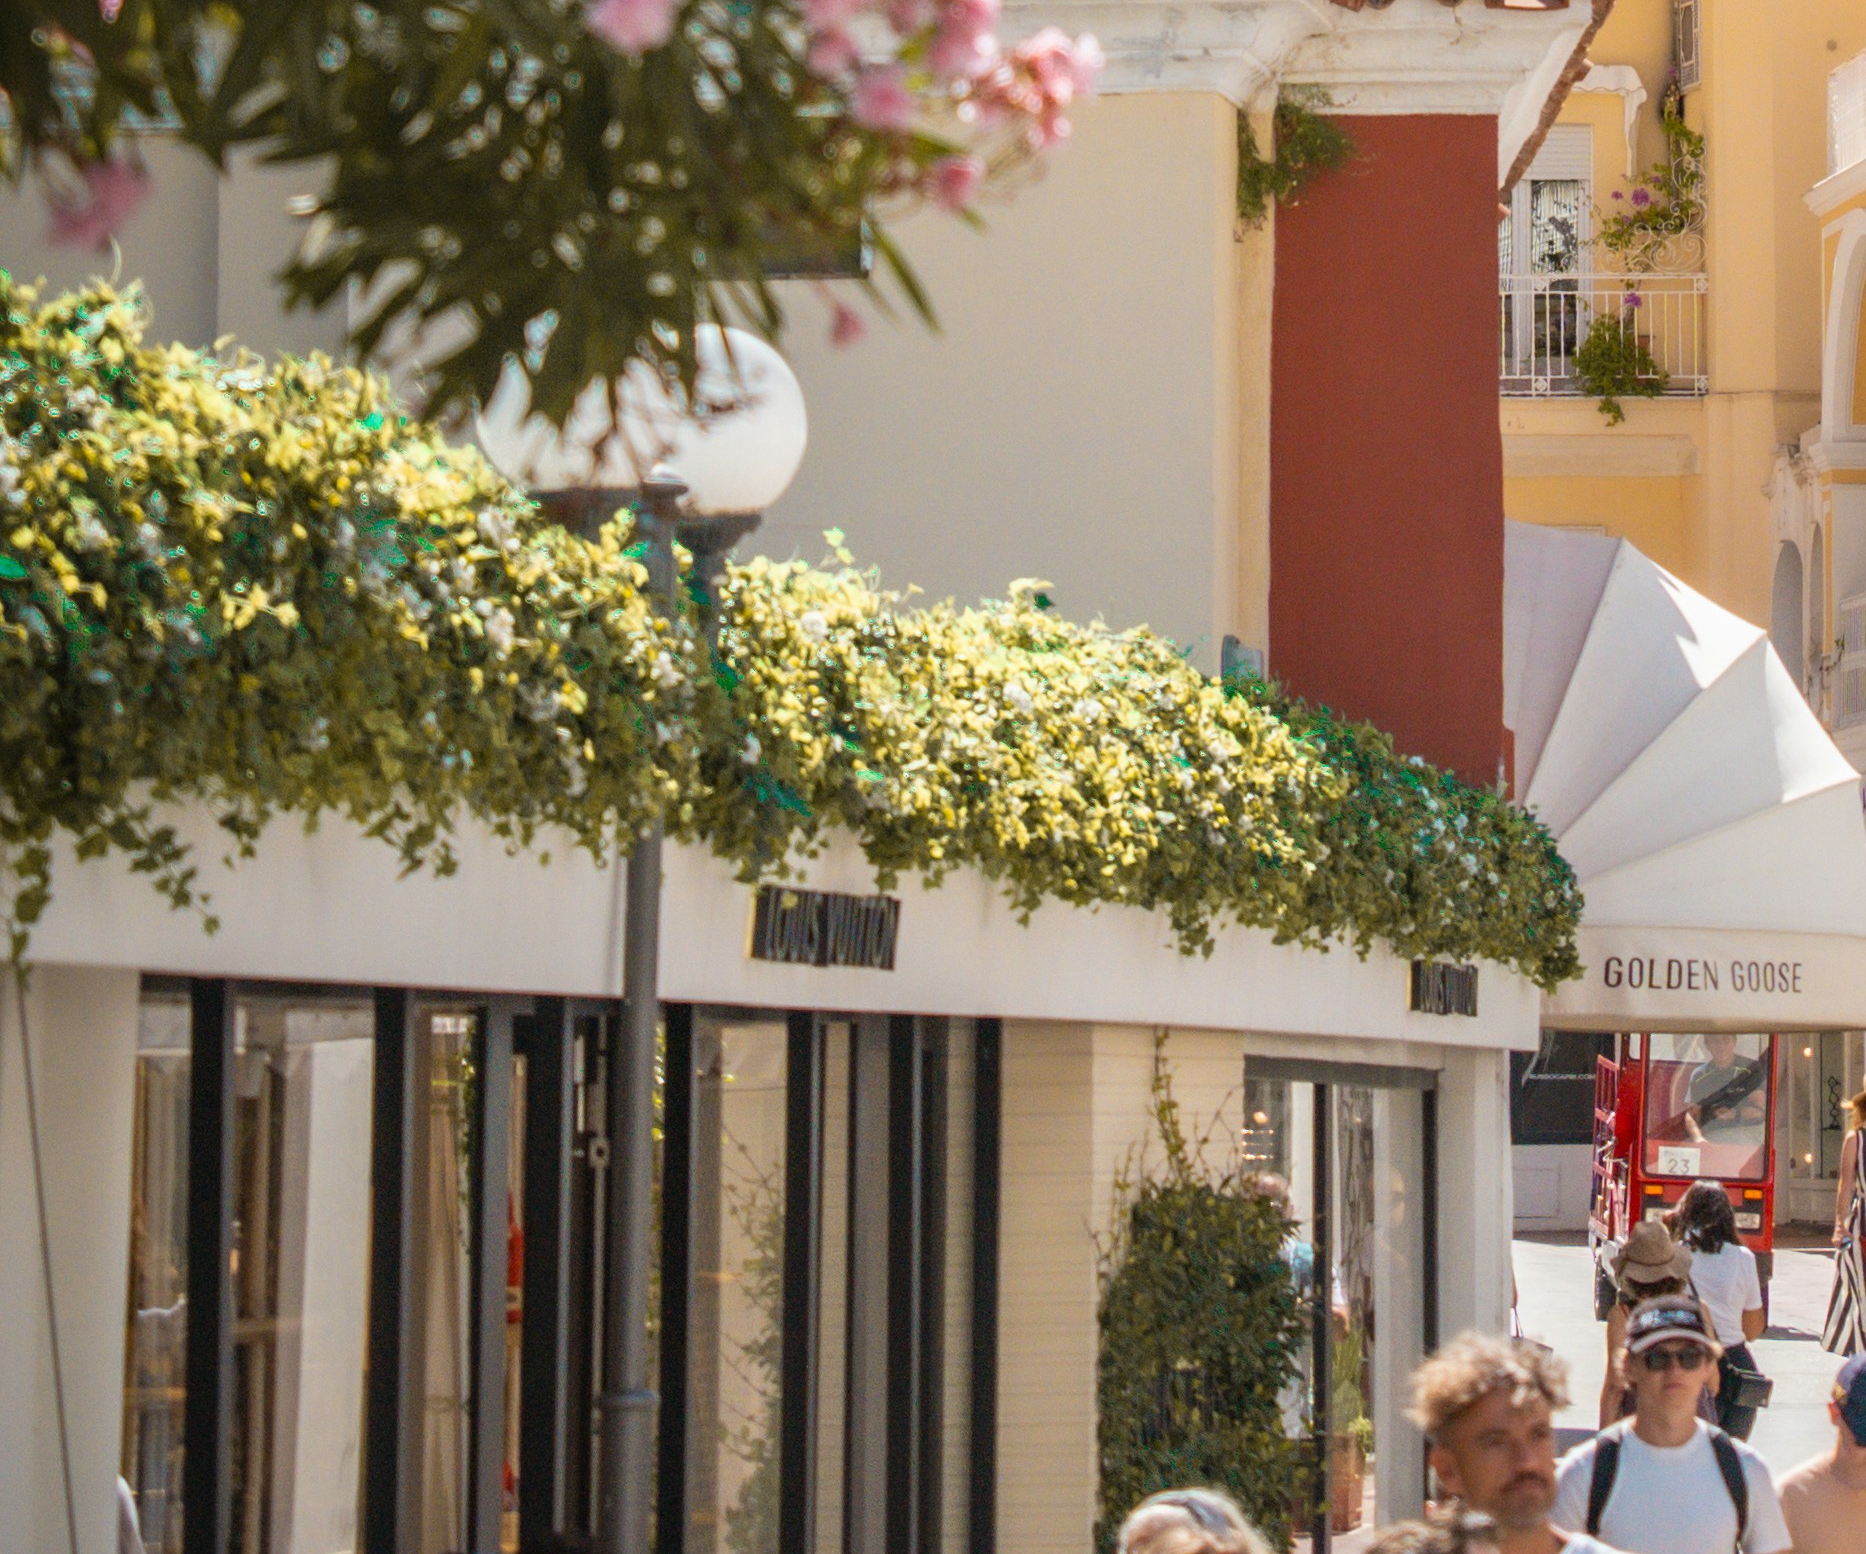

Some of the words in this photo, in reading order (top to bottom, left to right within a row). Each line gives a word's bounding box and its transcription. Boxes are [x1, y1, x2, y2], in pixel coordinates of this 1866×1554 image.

[1604, 956, 1719, 990] GOLDEN
[1731, 960, 1803, 994] GOOSE
[1667, 1158, 1690, 1175] 23
